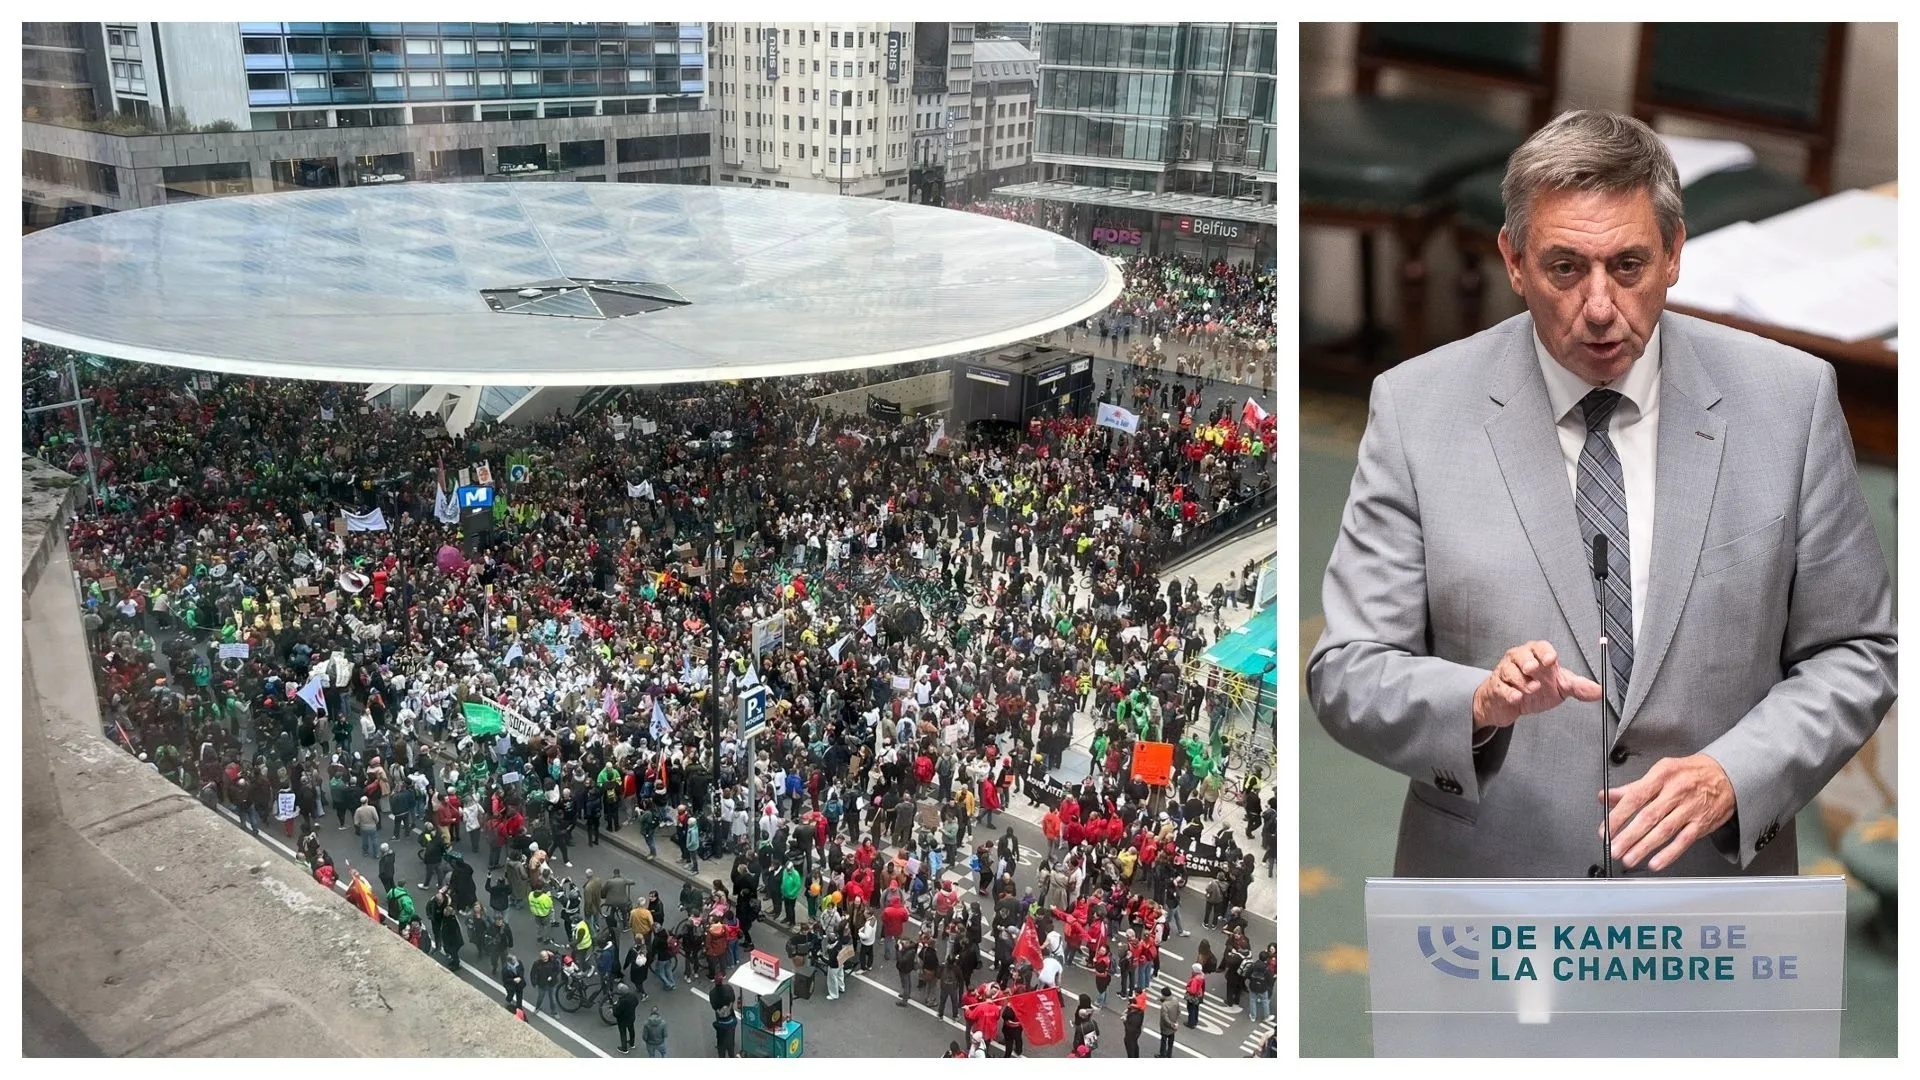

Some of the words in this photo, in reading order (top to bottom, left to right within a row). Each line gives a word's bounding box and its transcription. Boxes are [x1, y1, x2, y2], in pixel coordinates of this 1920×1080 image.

[888, 39, 898, 71] SIRU
[1092, 227, 1142, 244] POPS
[1193, 219, 1238, 238] Belfius
[465, 488, 487, 507] M
[748, 698, 758, 719] P
[1492, 926, 1536, 949] DE
[1554, 926, 1683, 950] KAMER
[1701, 925, 1746, 949] BE
[1492, 957, 1538, 981] LA
[1553, 956, 1734, 981] CHAMBRE
[1752, 956, 1798, 980] BE
